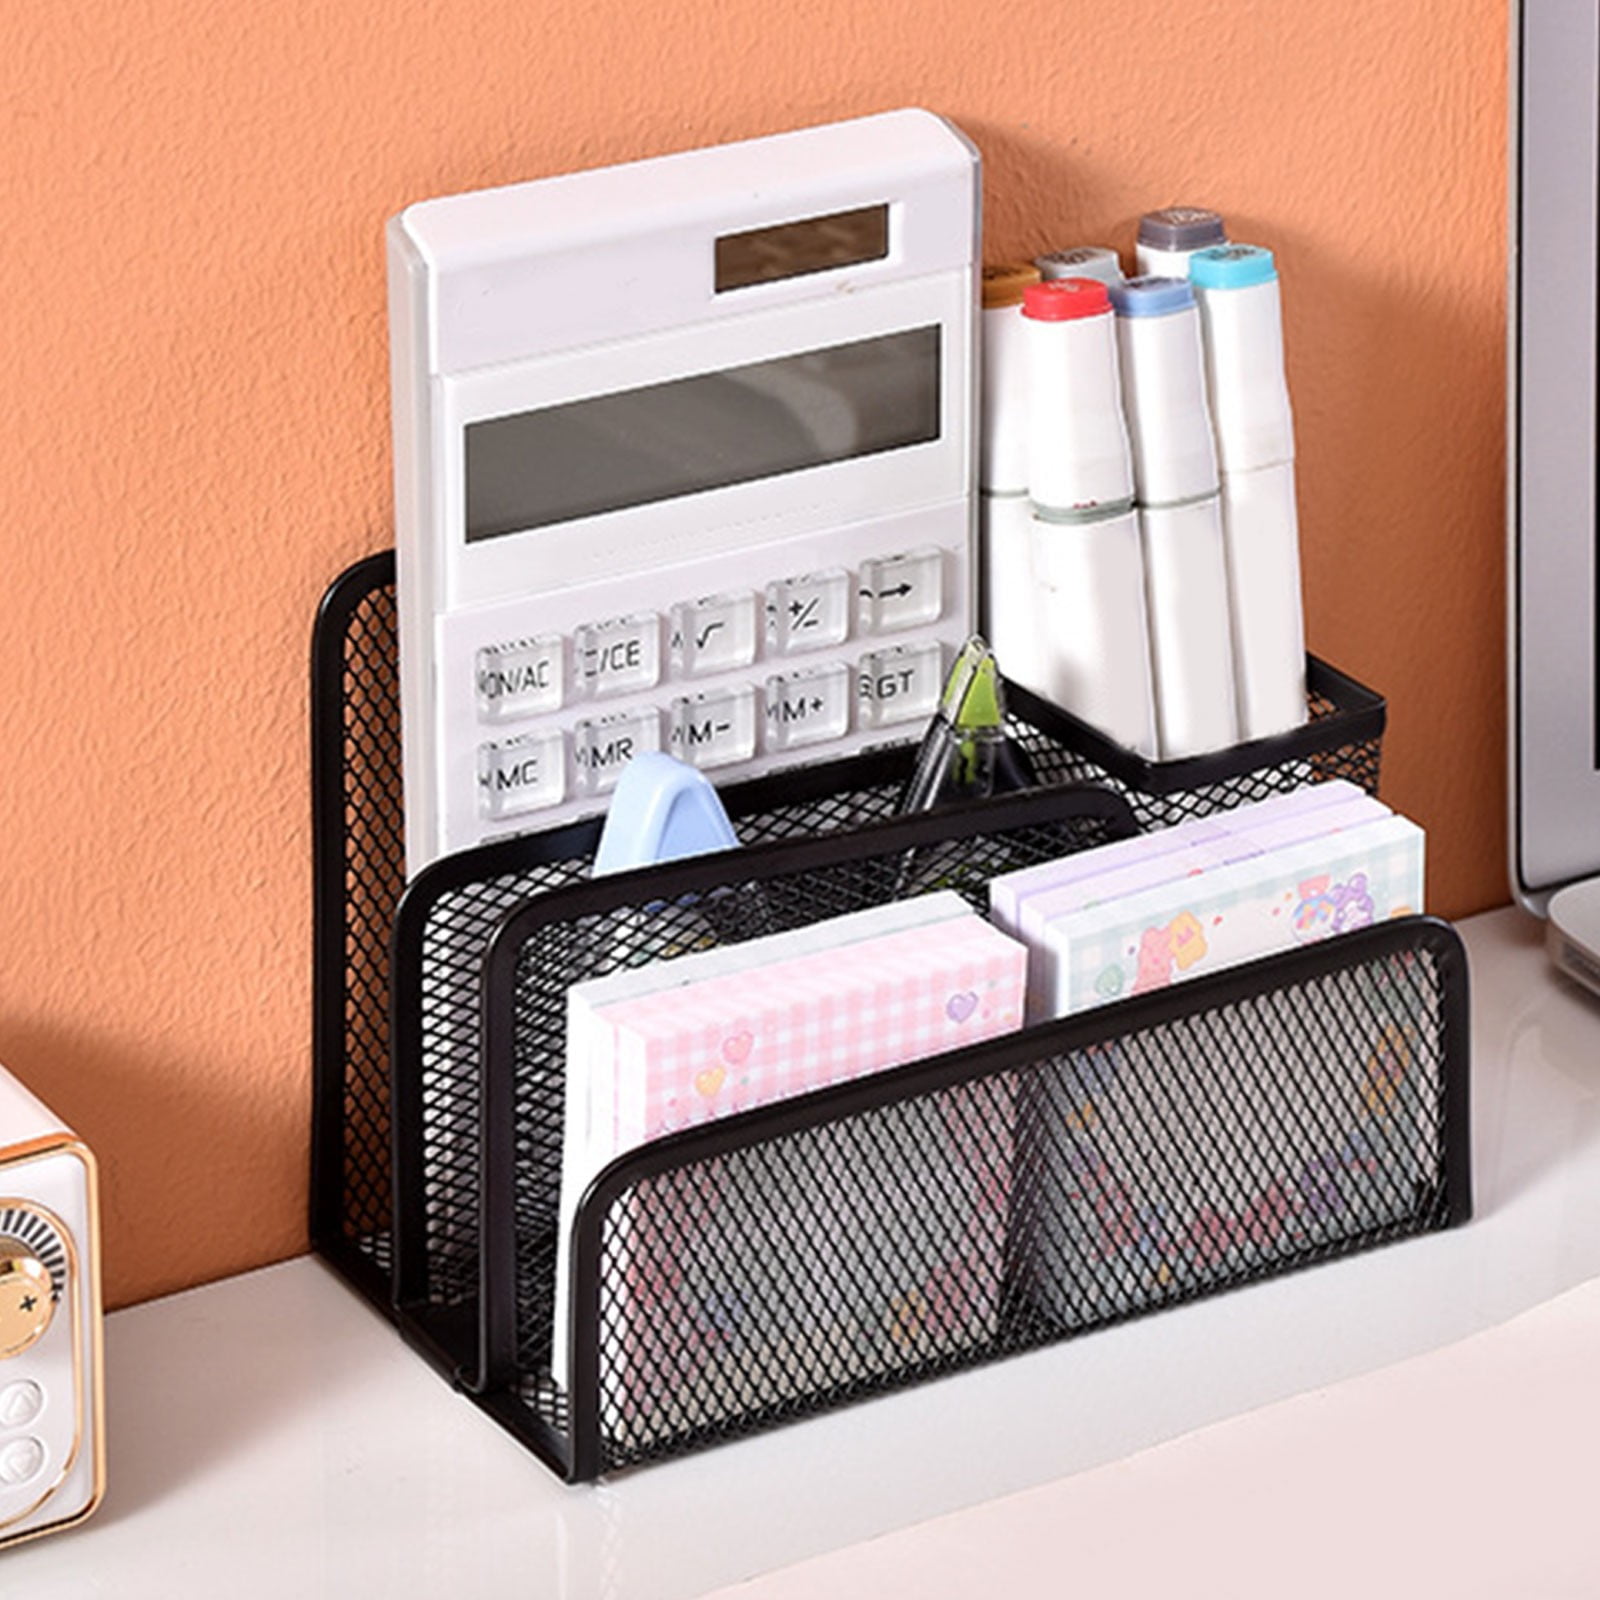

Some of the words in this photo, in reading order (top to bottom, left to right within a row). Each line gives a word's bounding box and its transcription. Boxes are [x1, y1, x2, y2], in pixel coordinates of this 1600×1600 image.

[486, 661, 550, 699] ON/AC
[876, 669, 915, 699] GT
[783, 697, 823, 723] M+
[591, 737, 634, 768] MR
[497, 760, 538, 790] MC
